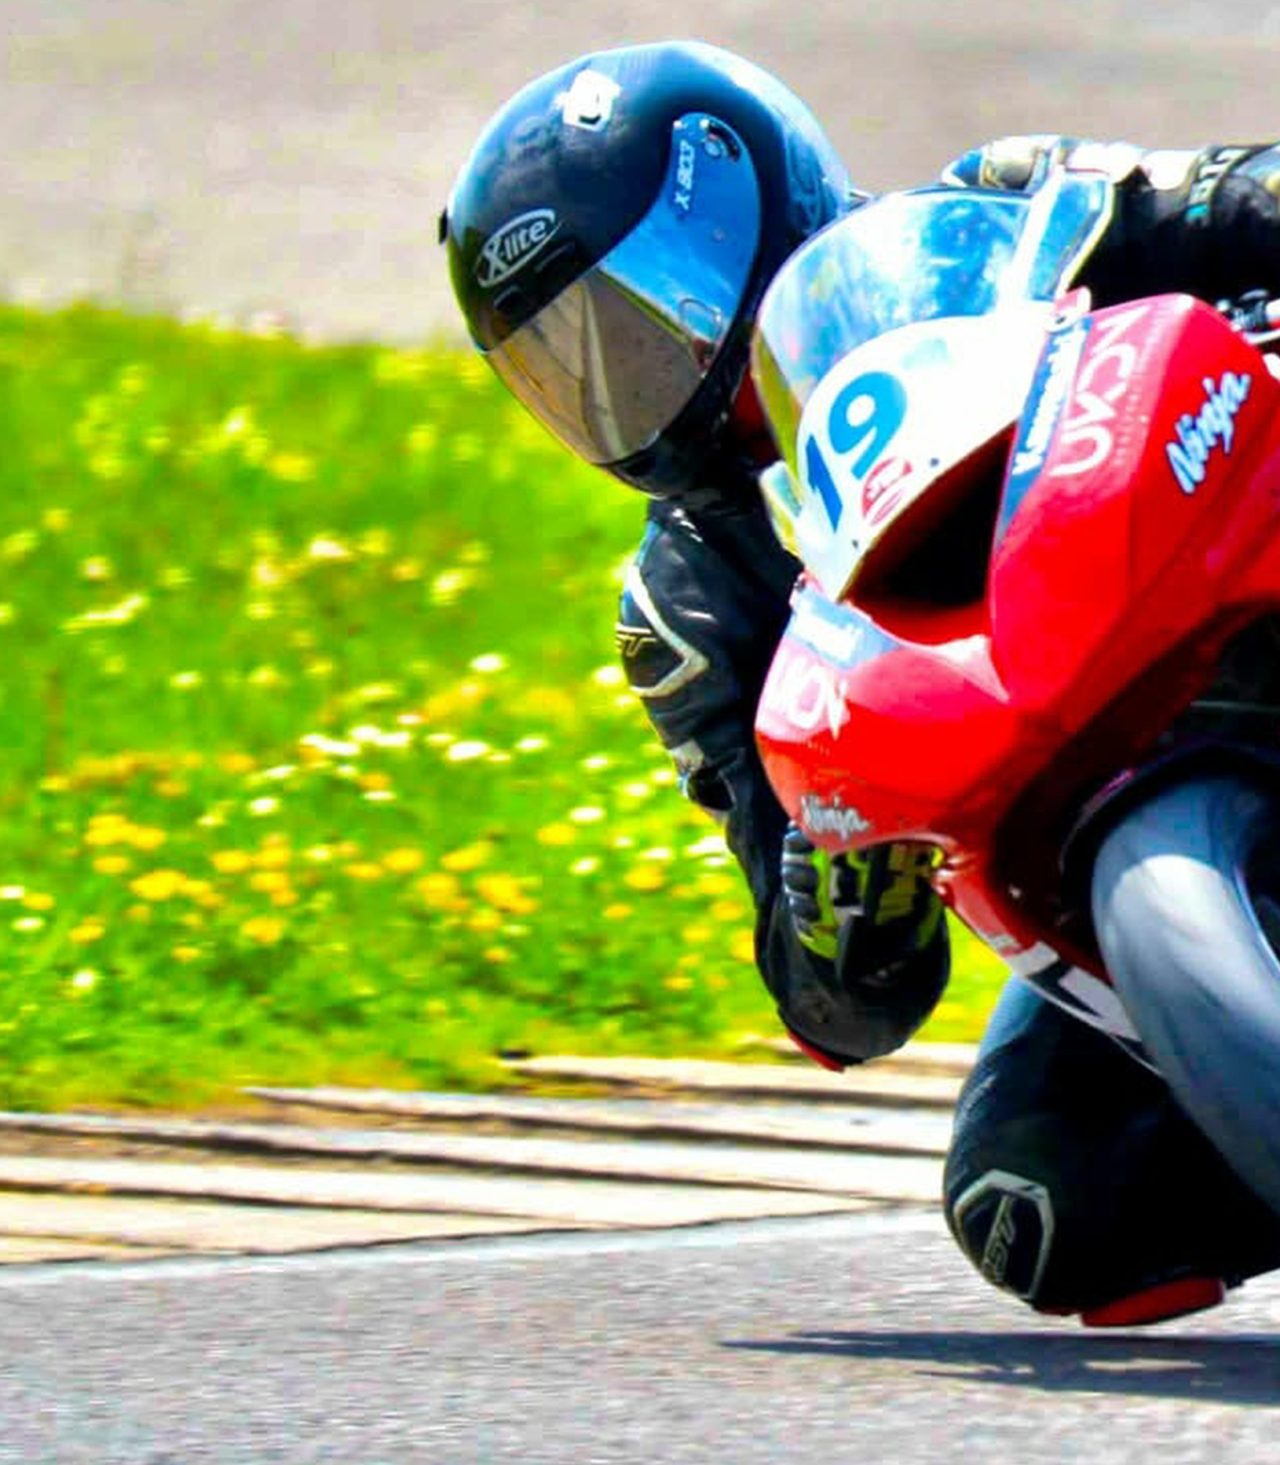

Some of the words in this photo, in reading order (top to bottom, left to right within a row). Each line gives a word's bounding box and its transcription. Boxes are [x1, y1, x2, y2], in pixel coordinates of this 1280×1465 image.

[479, 217, 551, 282] X-lite
[804, 370, 908, 533] 19
[1165, 370, 1252, 495] Ninja
[801, 793, 872, 842] Ninja
